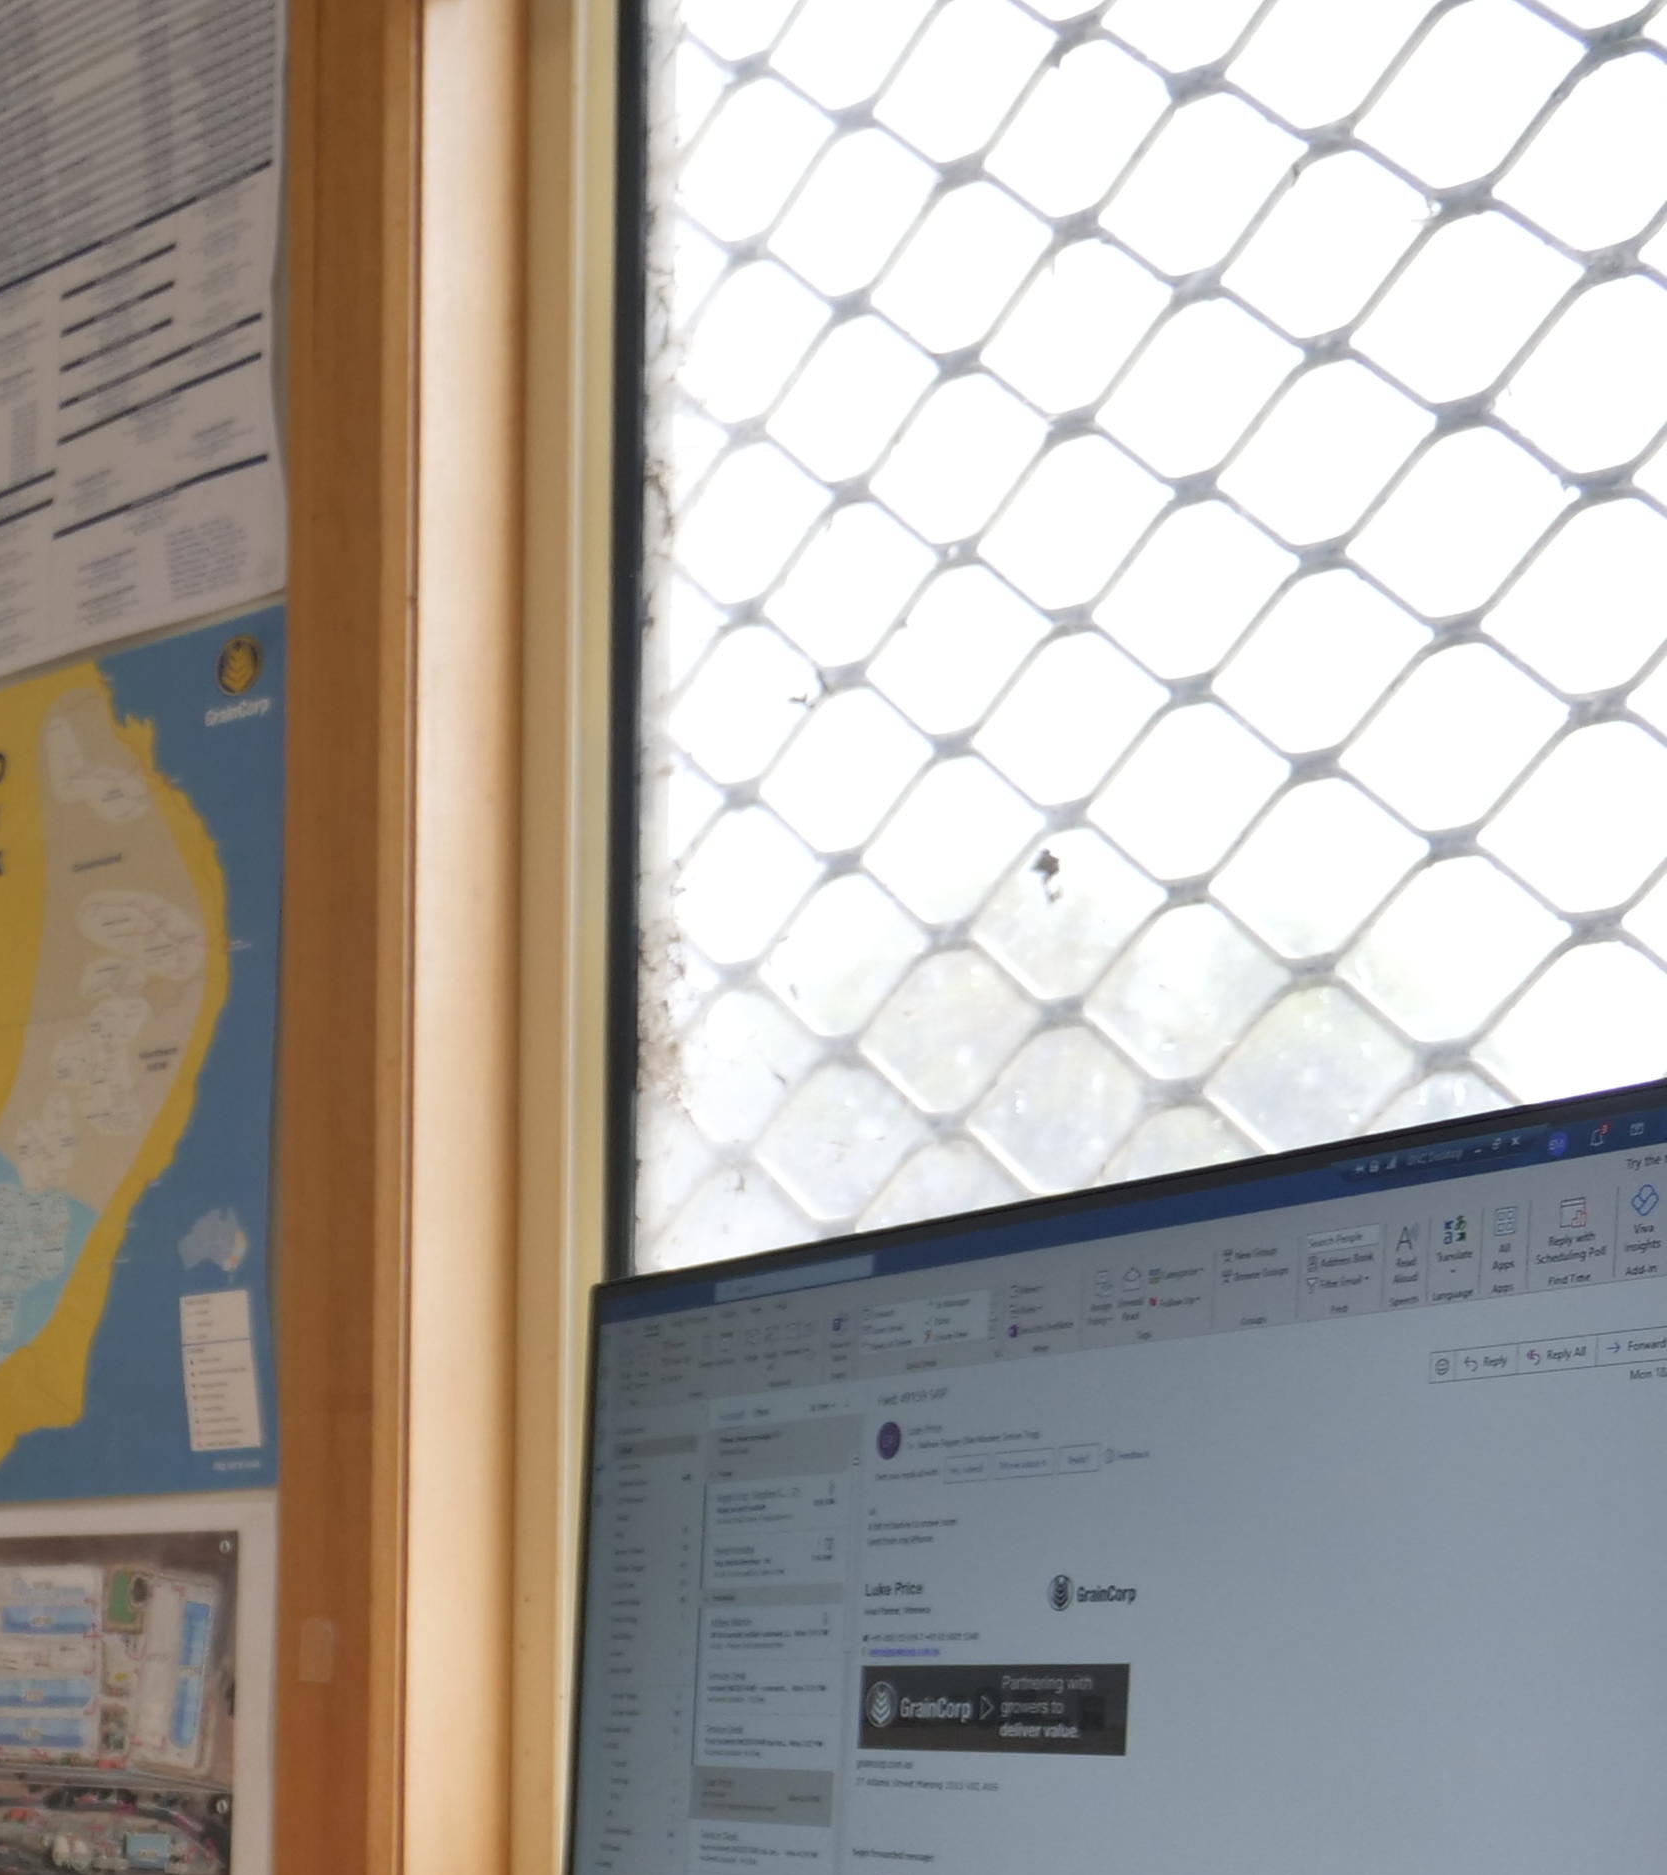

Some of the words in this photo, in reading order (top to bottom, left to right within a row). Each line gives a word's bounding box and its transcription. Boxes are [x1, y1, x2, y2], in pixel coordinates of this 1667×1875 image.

[1548, 1234, 1574, 1249] Reply
[1574, 1230, 1596, 1244] with
[1535, 1249, 1584, 1266] Scheduling
[1626, 1336, 1667, 1352] Forward
[1482, 1354, 1509, 1369] Reply
[1546, 1347, 1570, 1362] Reply
[1075, 1584, 1138, 1605] GrainCorp
[1000, 1675, 1065, 1695] Partnering
[1066, 1675, 1095, 1692] with
[899, 1696, 973, 1724] GrainCorp
[999, 1702, 1049, 1719] growers
[1049, 1700, 1067, 1715] to
[998, 1723, 1042, 1739] deliver
